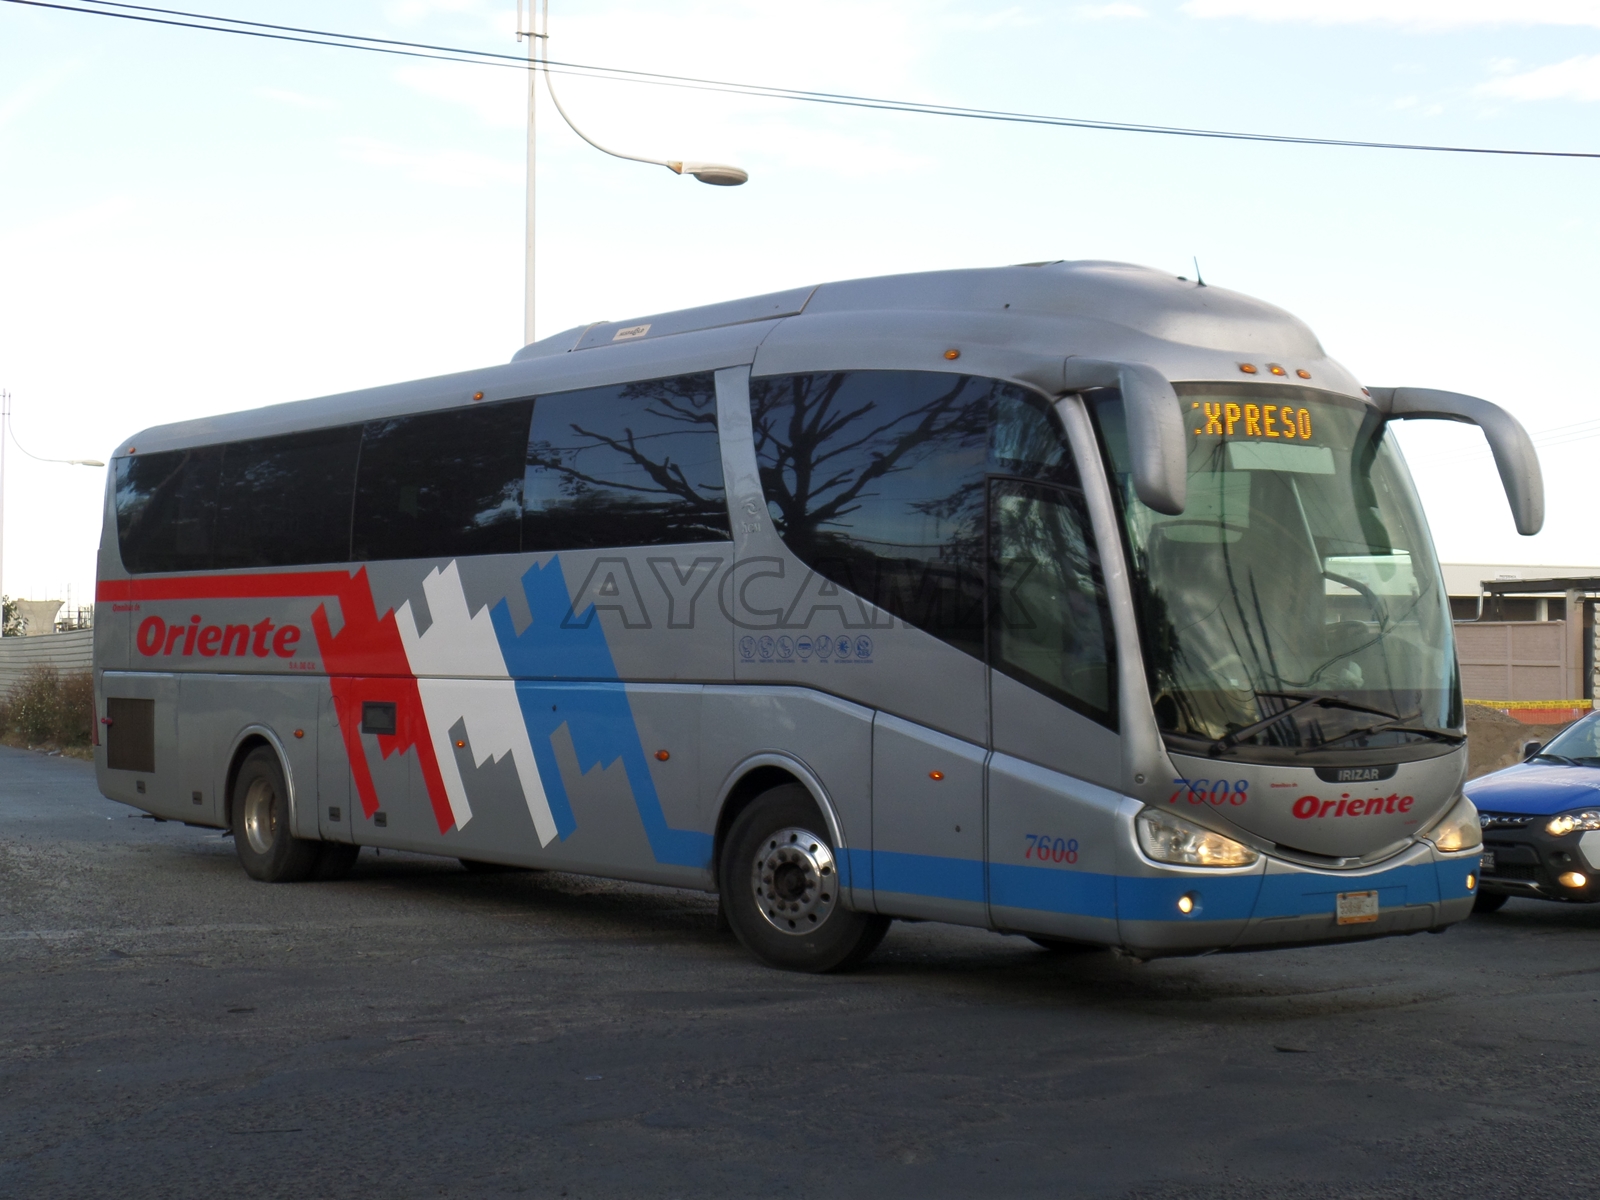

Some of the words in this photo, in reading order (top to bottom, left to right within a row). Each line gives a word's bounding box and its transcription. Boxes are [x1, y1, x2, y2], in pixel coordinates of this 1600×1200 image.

[1192, 402, 1312, 440] XPRESO
[136, 614, 301, 658] Oriente
[1338, 769, 1379, 781] IRIZAR
[1169, 778, 1249, 806] 7608
[1292, 793, 1414, 820] Oriente
[1025, 833, 1079, 864] 7608
